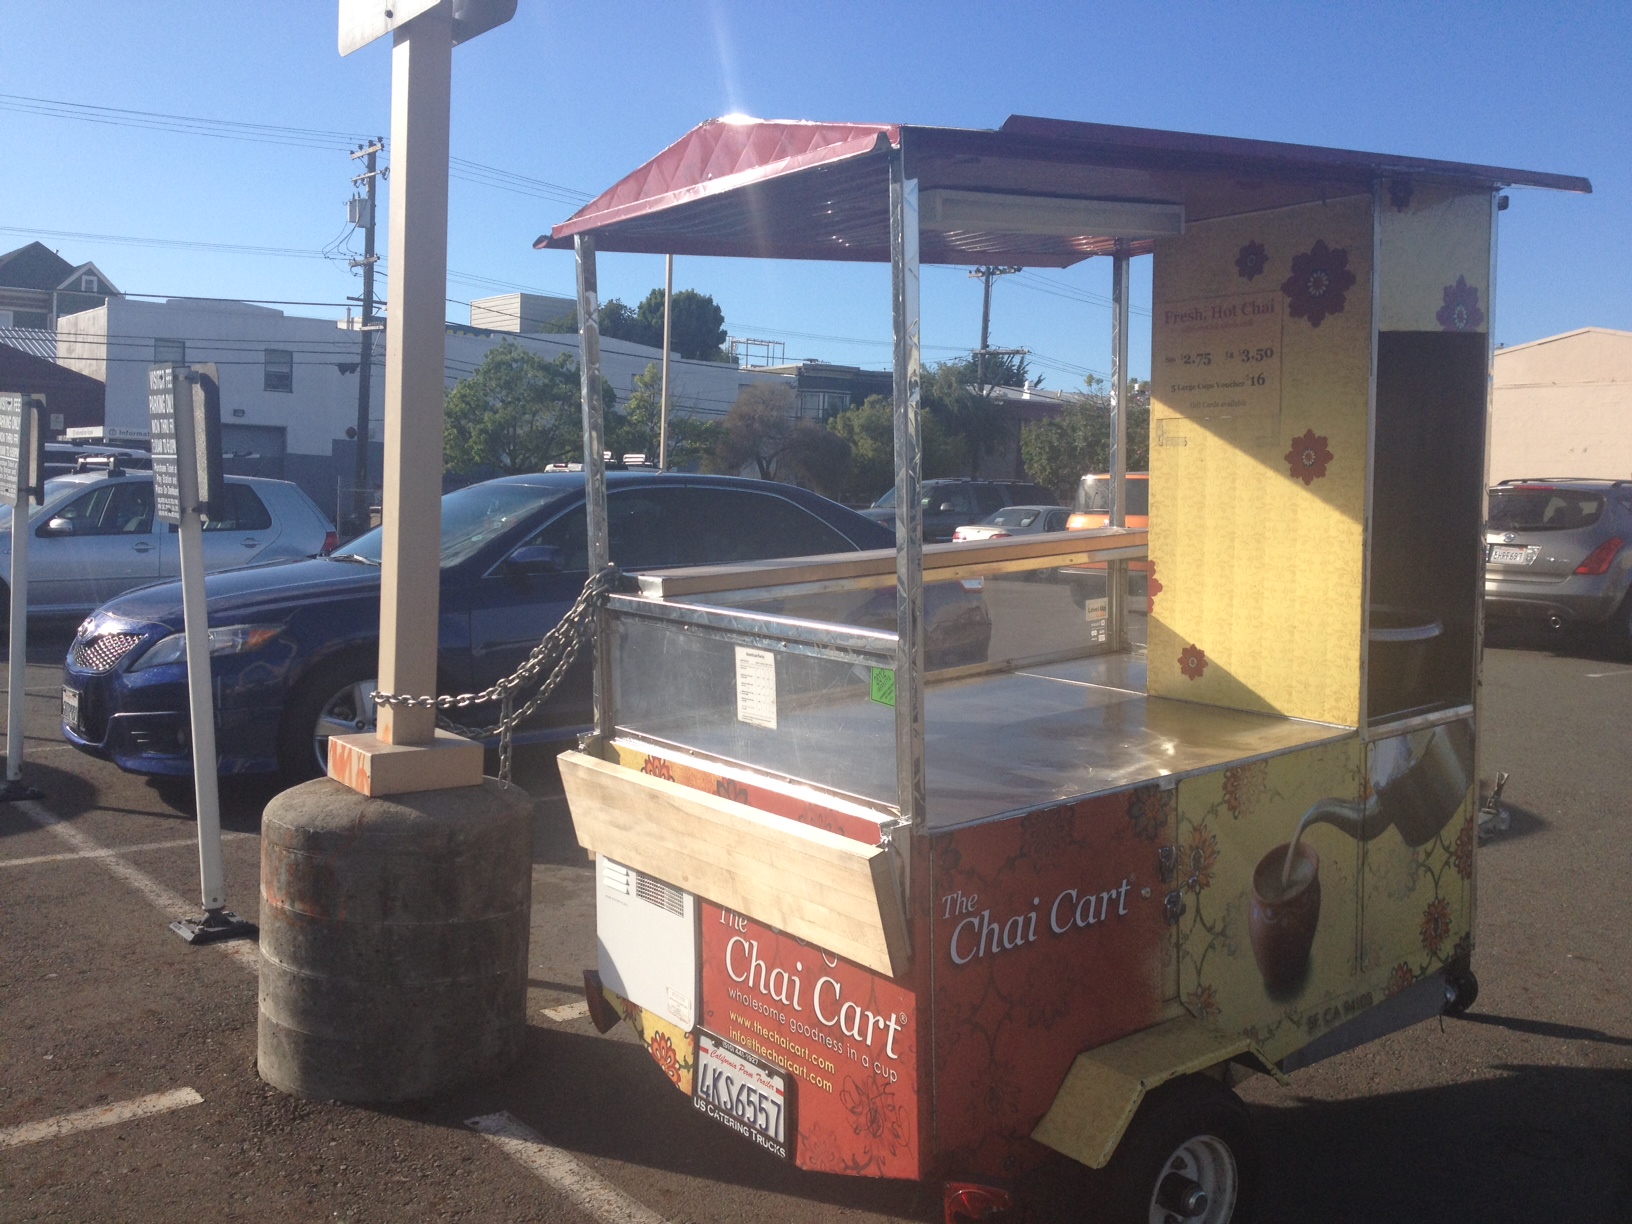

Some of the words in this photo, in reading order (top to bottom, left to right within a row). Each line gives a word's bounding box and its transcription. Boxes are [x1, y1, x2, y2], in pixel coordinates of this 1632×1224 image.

[1210, 304, 1237, 319] Hot
[1241, 298, 1274, 316] Chai
[0, 397, 13, 411] ISITOR
[148, 394, 166, 414] PARKING
[1170, 385, 1176, 393] 5
[1215, 379, 1245, 388] Voucher
[942, 890, 978, 919] The
[951, 897, 1040, 965] Chai
[726, 936, 803, 1011] Chai
[728, 986, 786, 1024] wholesome
[789, 1017, 843, 1054] goodness
[847, 1043, 858, 1061] in
[862, 1056, 869, 1068] a
[873, 1061, 898, 1084] cup
[729, 1010, 836, 1074] www.thechaicart.com
[729, 1026, 833, 1092] info@thechaicart.com
[700, 1062, 782, 1139] 4KS6557
[710, 1049, 737, 1070] California
[739, 1063, 755, 1079] Perm
[755, 1072, 775, 1091] Trailer
[693, 1096, 706, 1112] US
[707, 1105, 749, 1138] CATERING
[750, 1129, 786, 1158] TRUCKS
